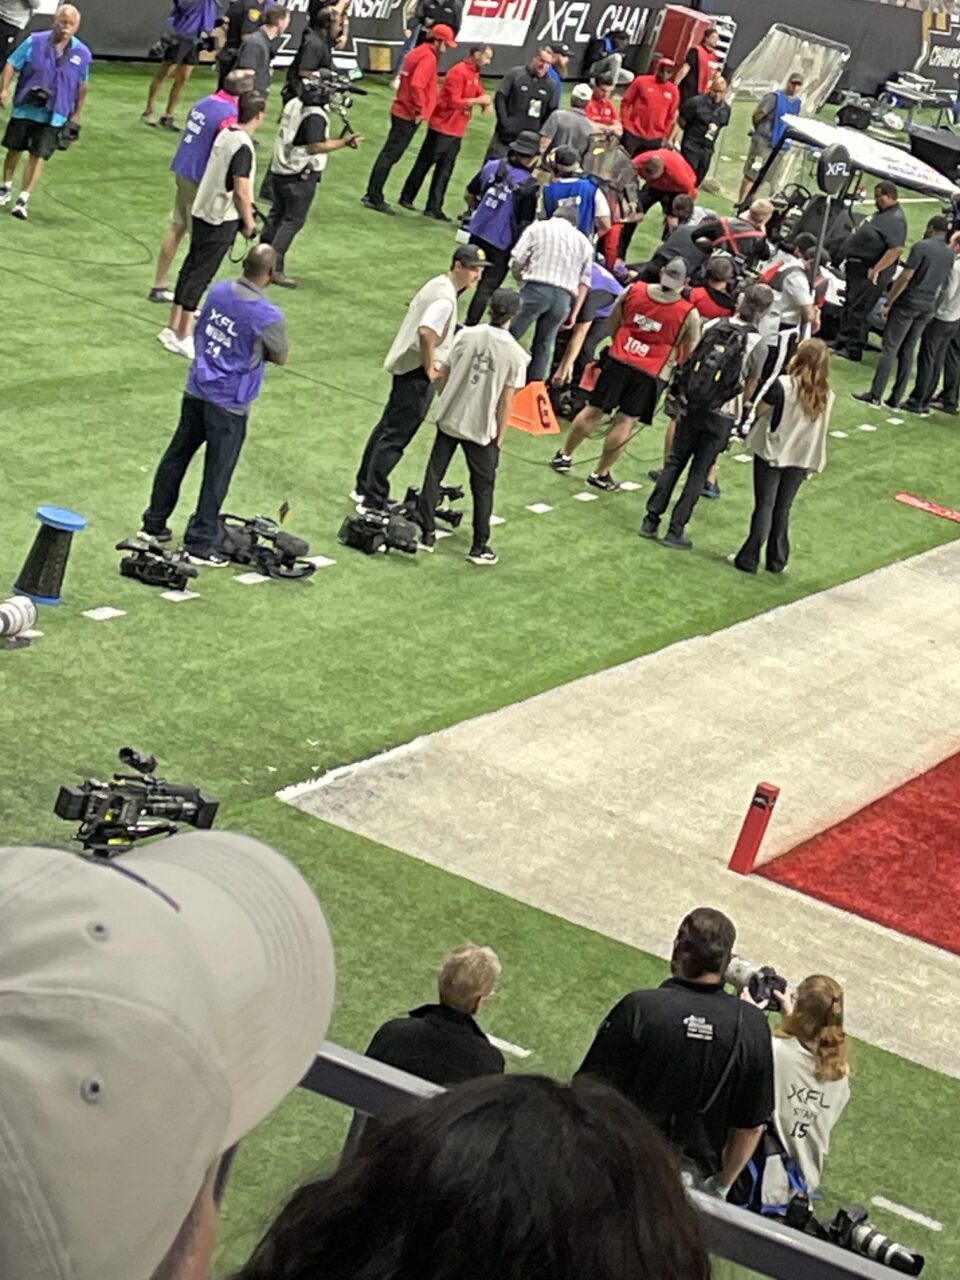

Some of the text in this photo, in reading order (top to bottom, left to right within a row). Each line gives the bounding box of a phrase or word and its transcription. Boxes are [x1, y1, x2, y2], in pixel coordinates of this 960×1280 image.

[537, 0, 592, 43] XFL
[825, 162, 850, 176] XFL
[209, 308, 238, 337] XFL
[787, 1083, 831, 1109] XFL
[790, 1120, 810, 1138] 15
